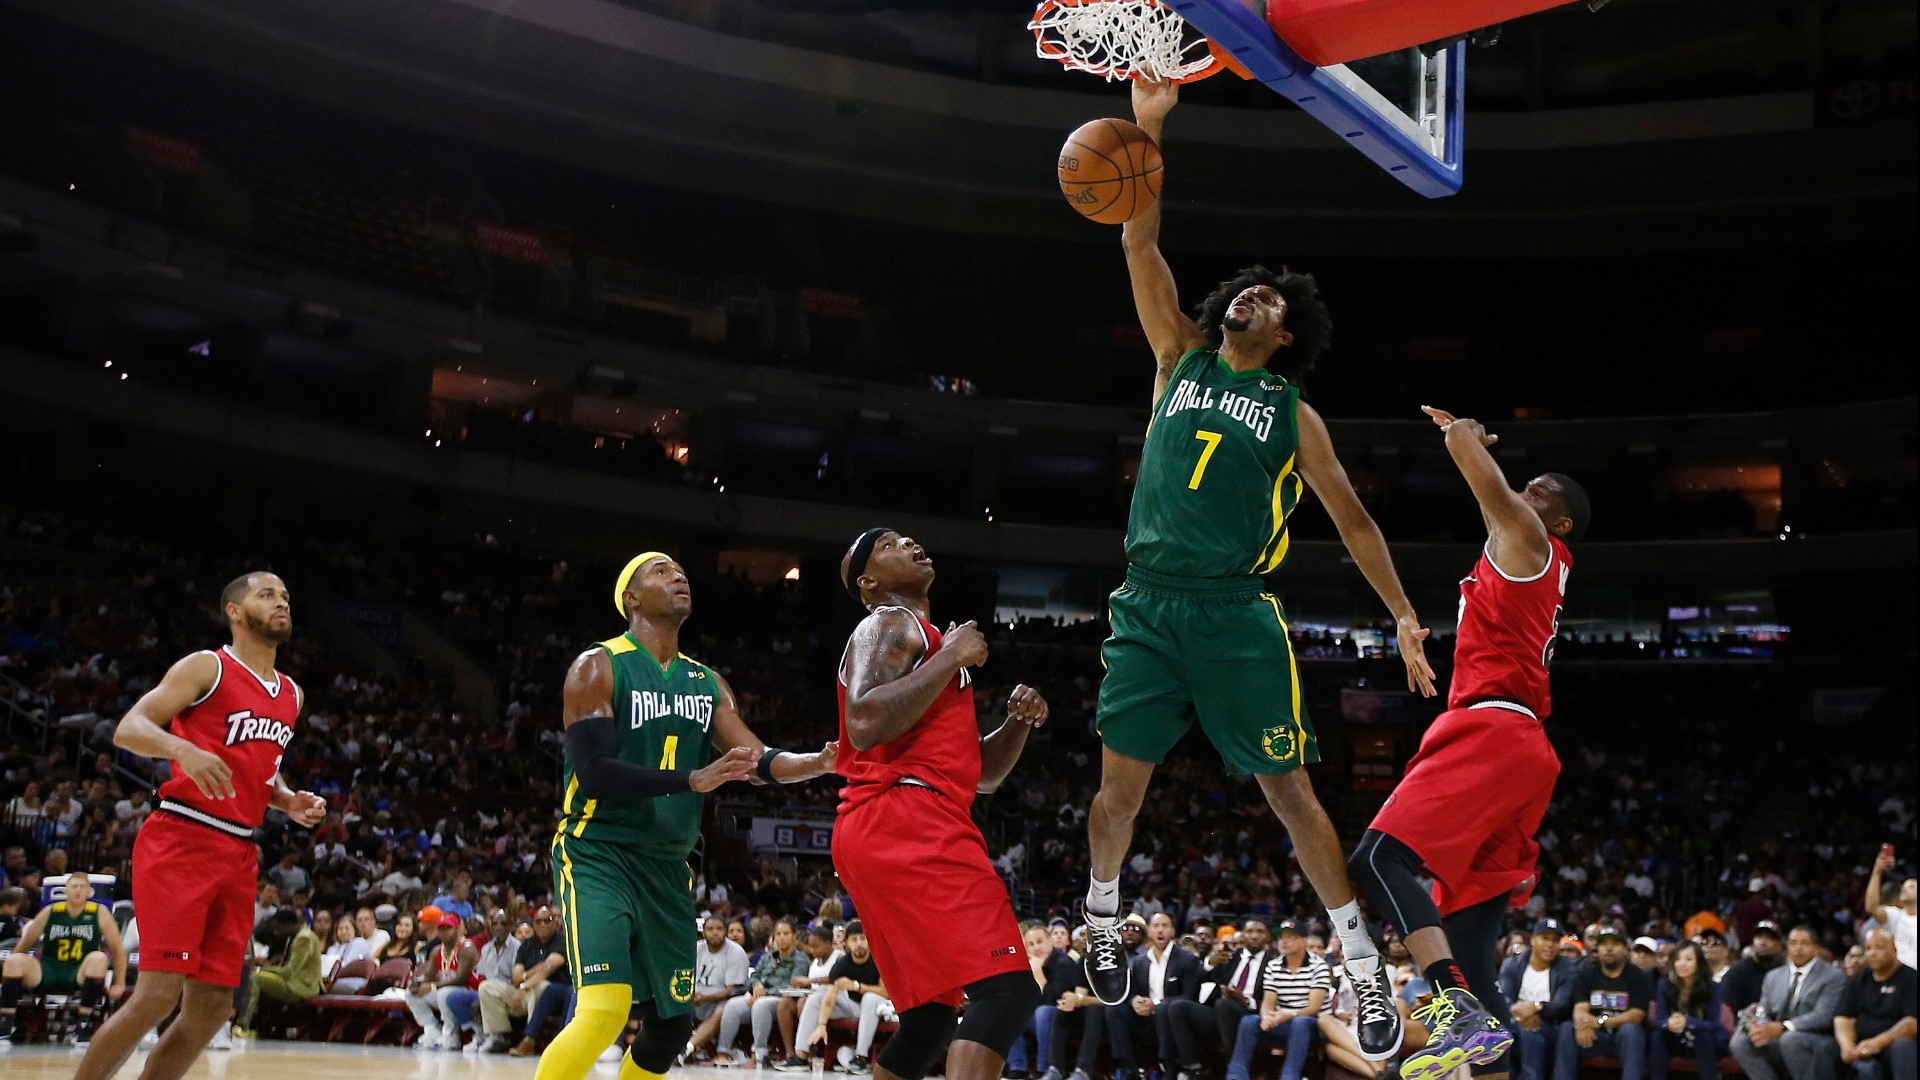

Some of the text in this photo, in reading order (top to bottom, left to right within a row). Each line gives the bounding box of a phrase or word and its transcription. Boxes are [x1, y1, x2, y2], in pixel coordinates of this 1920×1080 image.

[1259, 380, 1284, 391] BIG3
[1165, 379, 1276, 443] BALL HOGS
[1188, 429, 1223, 491] 7
[631, 689, 713, 734] BALL HOGS
[57, 938, 84, 961] 24
[583, 963, 610, 975] BIG3
